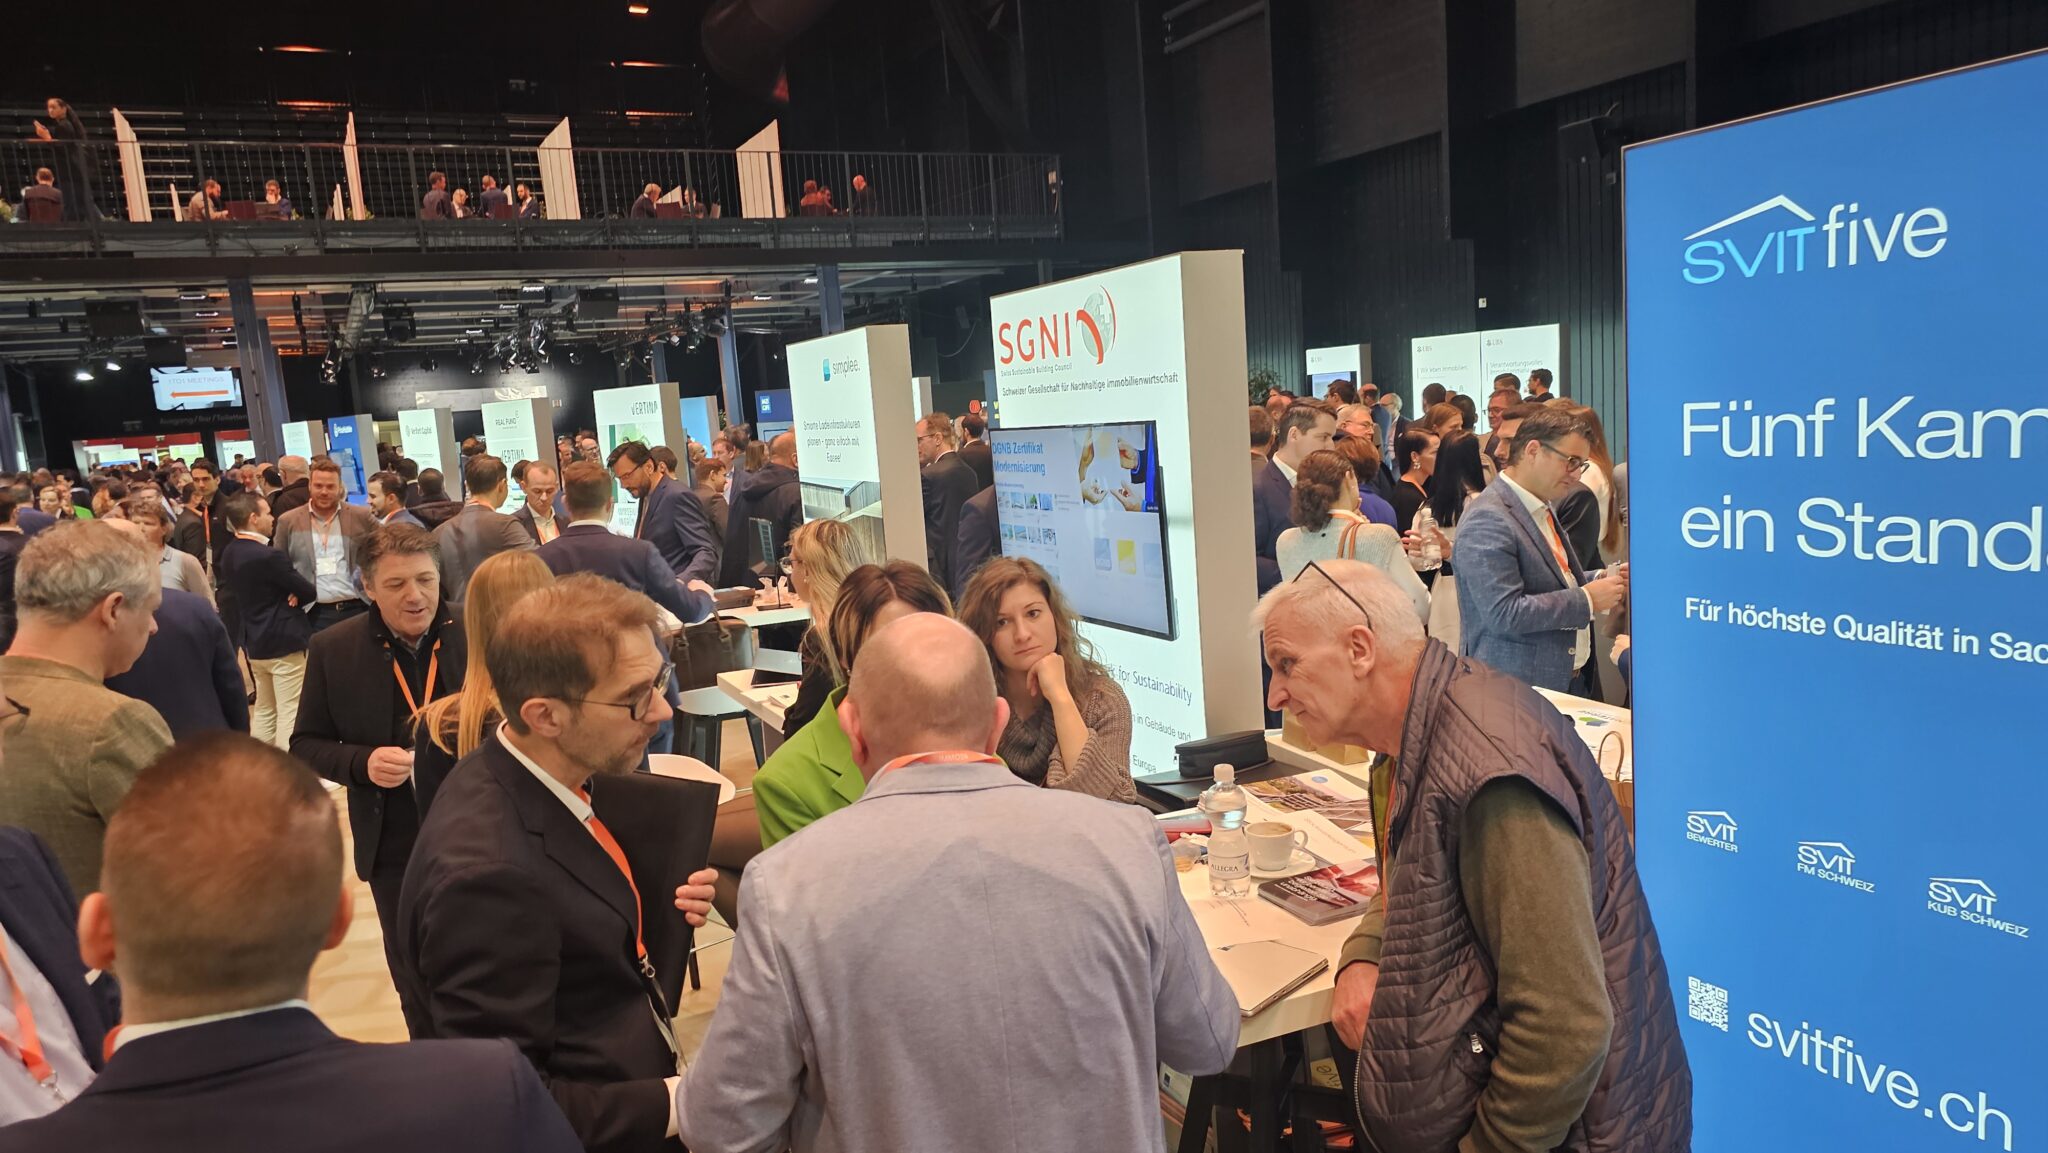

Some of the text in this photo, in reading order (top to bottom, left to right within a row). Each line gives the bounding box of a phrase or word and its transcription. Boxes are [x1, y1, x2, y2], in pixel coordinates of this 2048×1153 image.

[998, 311, 1072, 365] SGNI
[1012, 367, 1036, 376] Sustainable
[1036, 365, 1054, 374] Building
[1054, 362, 1073, 372] Council
[1002, 386, 1027, 397] Schweizer
[1027, 382, 1060, 395] Gesellschaft
[1061, 381, 1069, 392] für
[1070, 378, 1105, 393] Nachhaltige
[1682, 397, 1836, 458] Fünf
[992, 441, 1044, 455] DGNB Zertifikat
[994, 460, 1046, 476] Modernisierung
[1681, 494, 2048, 572] ein Stand
[1685, 597, 1723, 621] Für
[1728, 601, 1826, 635] höchste
[1833, 615, 1943, 652] Qualität
[1952, 627, 1979, 656] in
[1118, 665, 1131, 682] for
[1132, 671, 1192, 706] Sustainability
[1144, 716, 1176, 737] Gebäude
[1686, 814, 1738, 844] SVIT
[1686, 832, 1738, 853] BEWERTER
[1211, 863, 1239, 872] ALLEGRA
[1797, 845, 1856, 876] SVIT
[1797, 862, 1876, 893] FM SCHWEIZ
[1928, 881, 1998, 916] SVIT
[1927, 900, 2030, 938] KUB SCHWEIZ
[1747, 1012, 2013, 1152] svitfive.ch
